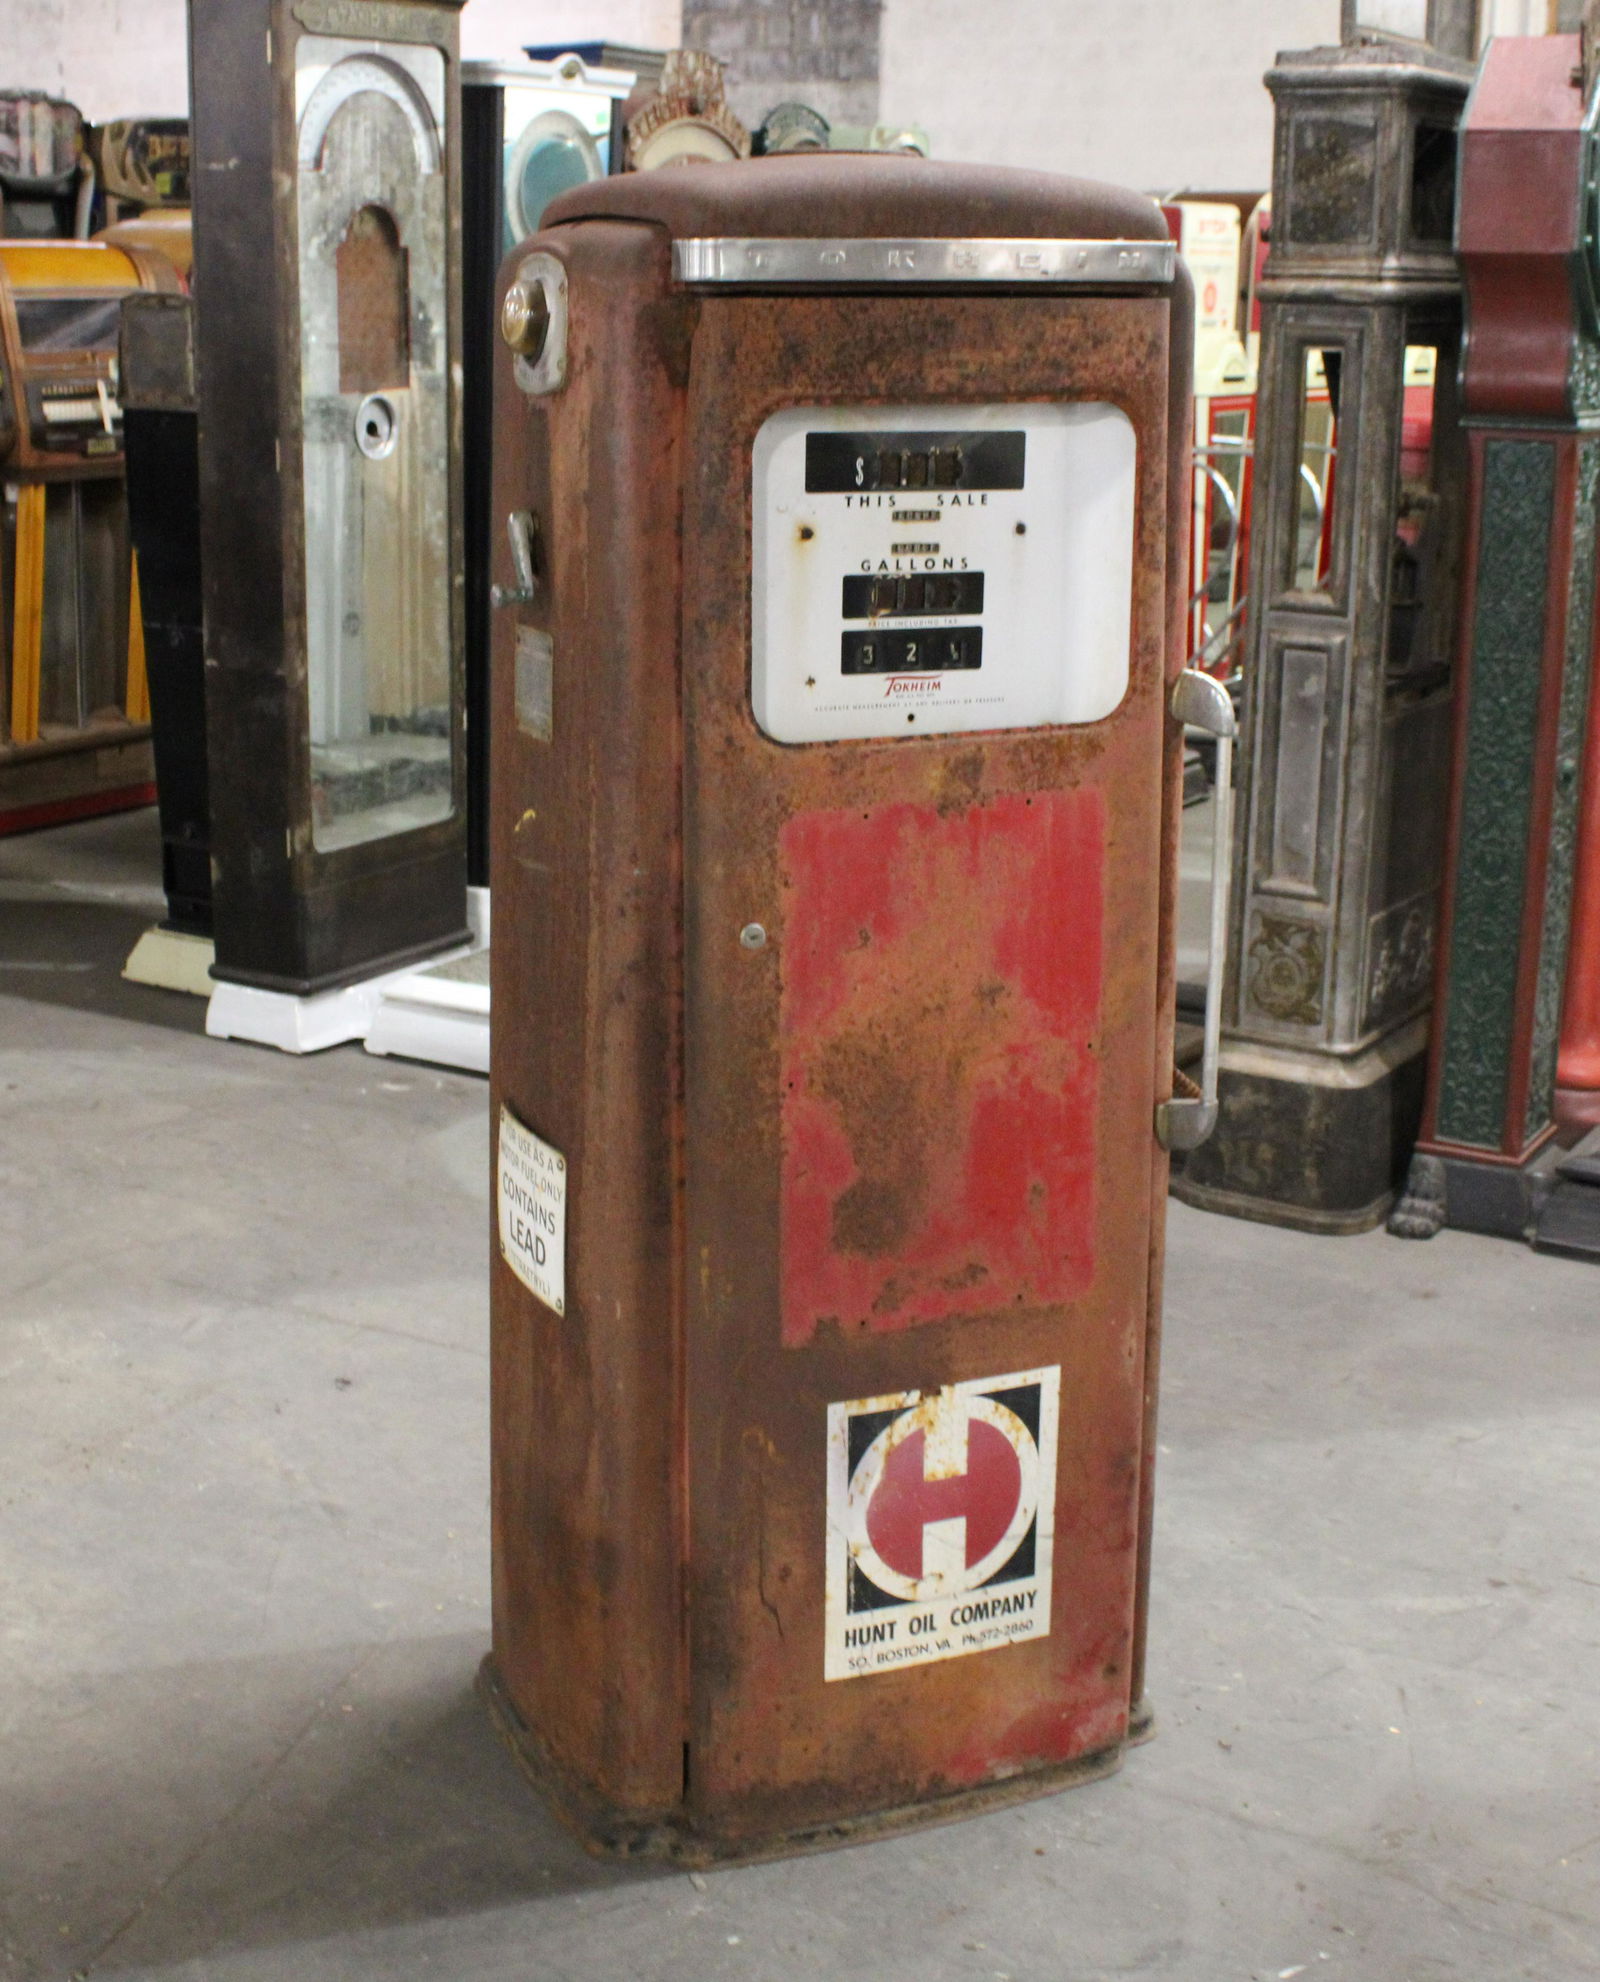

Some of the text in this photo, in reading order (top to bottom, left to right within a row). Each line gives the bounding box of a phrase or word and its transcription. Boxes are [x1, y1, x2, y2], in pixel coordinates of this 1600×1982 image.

[747, 248, 1141, 272] TOKHEIM
[845, 493, 989, 509] THIS SALE
[861, 556, 969, 572] GALLONS
[895, 618, 939, 627] INCLUDING
[884, 673, 943, 697] TOKHEIM
[518, 1133, 532, 1158] USE
[533, 1146, 545, 1168] AS
[547, 1158, 554, 1175] A
[521, 1160, 539, 1187] FUEL
[541, 1177, 562, 1204] ONLY
[502, 1171, 556, 1236] CONTAINS
[510, 1210, 546, 1266] LEAD
[844, 1589, 1038, 1648] HUNT OIL COMPANY
